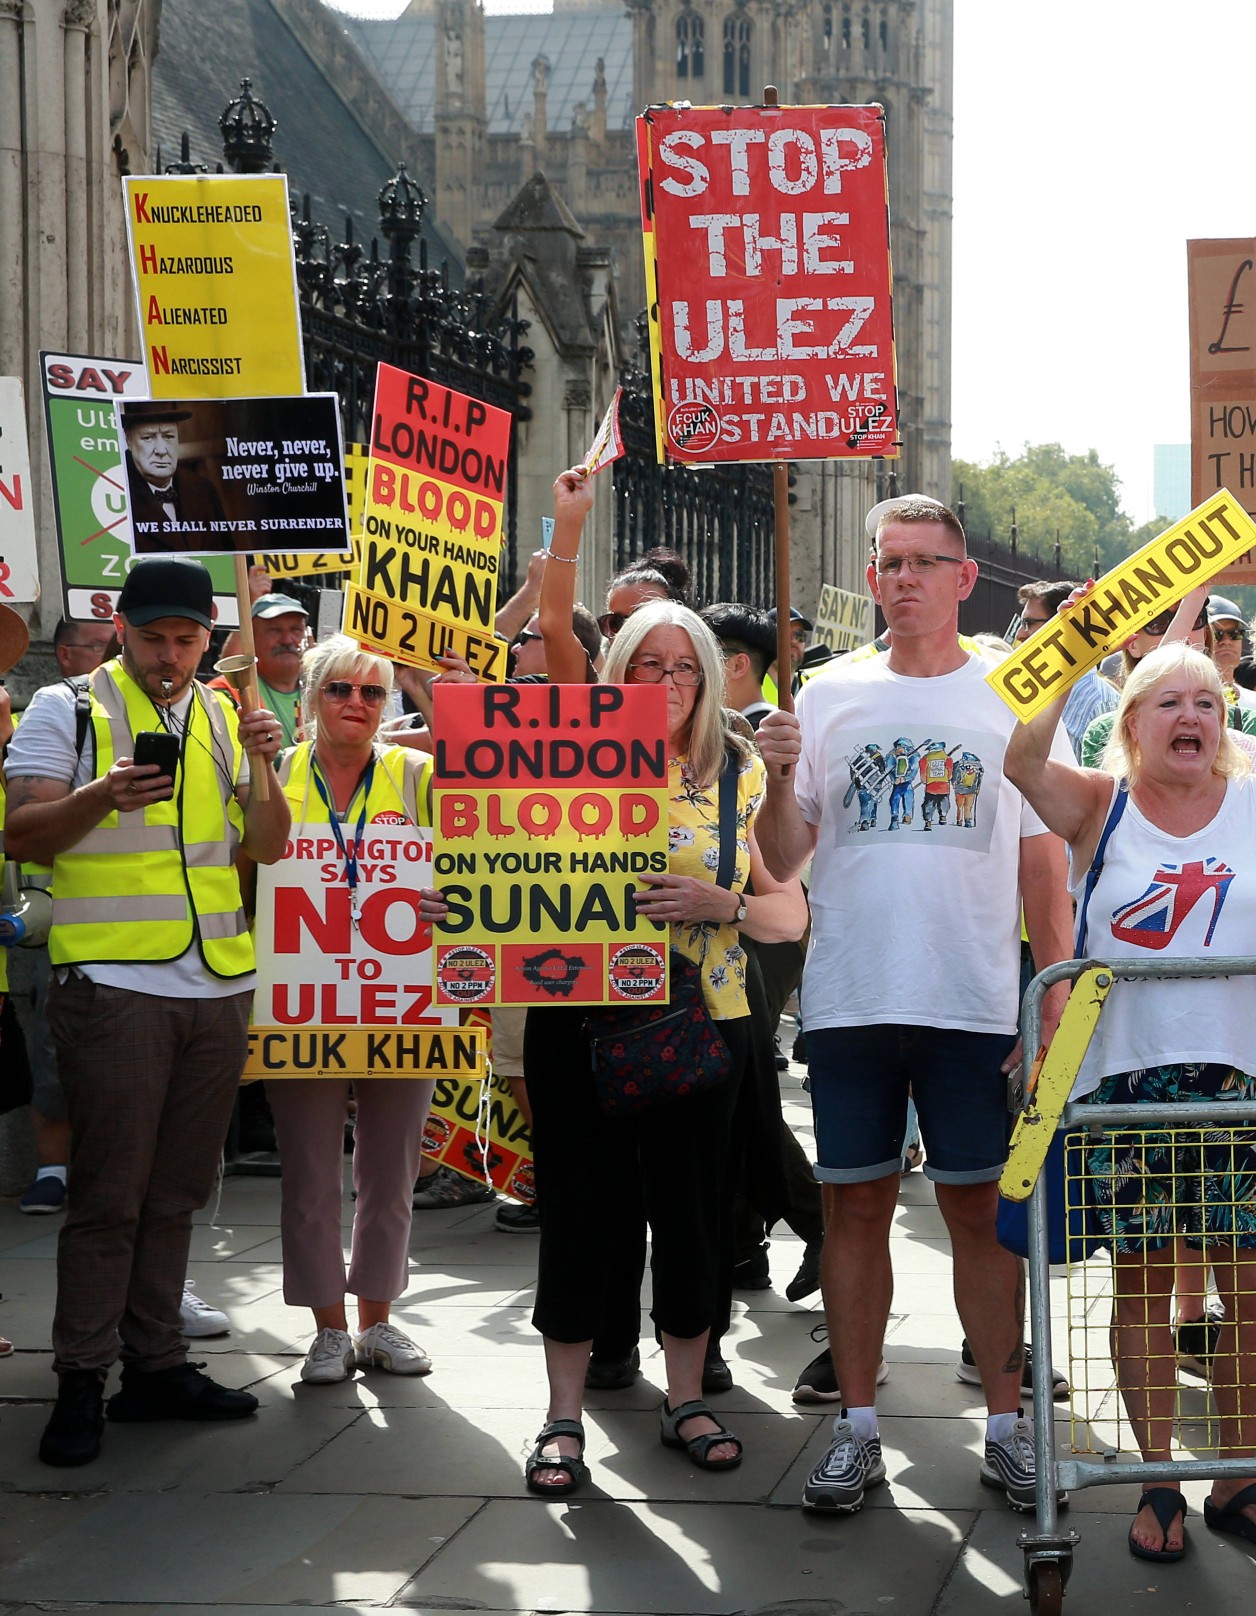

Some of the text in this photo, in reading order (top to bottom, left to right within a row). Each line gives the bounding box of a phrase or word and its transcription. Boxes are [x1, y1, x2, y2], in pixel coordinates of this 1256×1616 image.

[659, 128, 873, 197] STOP
[134, 193, 262, 223] KNUCKLEHEADED
[140, 245, 233, 275] HAZARDOUS
[689, 212, 854, 277] THE
[148, 295, 227, 325] ALIENATED
[672, 296, 878, 362] ULEZ
[152, 345, 241, 375] NARCISSIST
[48, 364, 131, 393] SAY
[671, 373, 887, 404] UNITED WE
[77, 409, 118, 429] Ult
[405, 376, 487, 437] R.I.P
[676, 411, 710, 423] FCUK
[848, 406, 884, 418] STOP
[672, 421, 716, 437] KHAN
[720, 411, 840, 443] STAND
[841, 416, 893, 434] ULEZ
[226, 437, 331, 460] Never, never,
[374, 413, 505, 494] LONDON
[221, 458, 339, 483] never give up.
[247, 481, 317, 495] Winston Churchill
[372, 463, 497, 542] BLOOD
[135, 517, 344, 533] WE SHALL NEVER SURRENDER
[366, 515, 391, 543] ON
[395, 525, 439, 558] YOUR
[443, 541, 497, 574] HANDS
[367, 541, 492, 627] KHAN
[819, 588, 870, 630] SAY NO
[1003, 628, 1077, 705] GET
[1069, 556, 1175, 648] KHAN
[1165, 504, 1241, 576] OUT
[352, 593, 389, 641] NO
[400, 612, 417, 653] 2
[483, 685, 624, 729] R.I.P
[435, 739, 666, 779] LONDON
[375, 816, 405, 825] STOP
[440, 792, 659, 842] BLOOD
[320, 863, 397, 884] SAYS
[434, 851, 667, 875] ON YOUR HANDS
[274, 886, 434, 956] NO
[335, 958, 383, 981] TO
[272, 984, 442, 1026] ULEZ
[367, 1034, 477, 1069] KHAN
